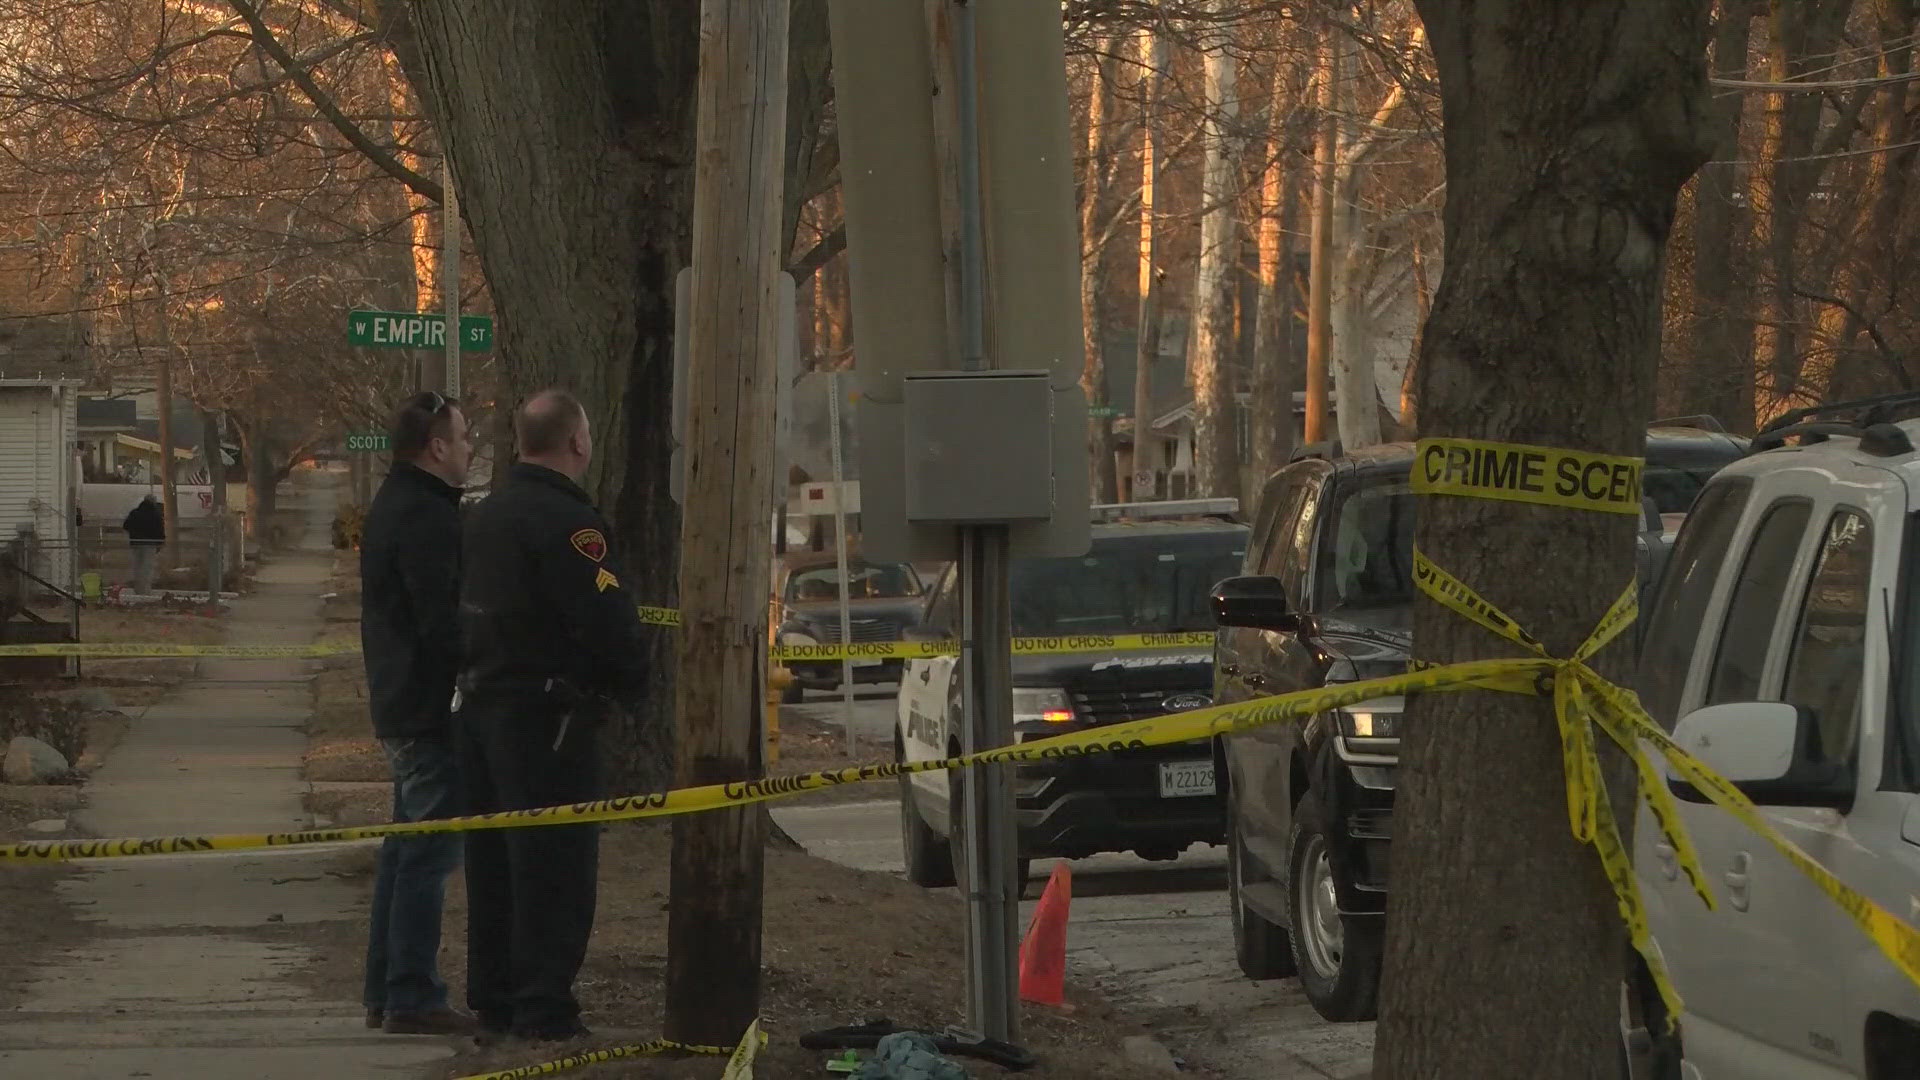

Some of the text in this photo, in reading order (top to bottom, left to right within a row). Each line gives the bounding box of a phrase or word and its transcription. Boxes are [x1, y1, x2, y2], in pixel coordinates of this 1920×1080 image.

[356, 317, 486, 347] W EMPIR ST
[349, 435, 387, 450] SCOTT
[1424, 444, 1642, 503] CRIME SCEN
[793, 645, 813, 657] DO
[816, 644, 842, 657] NOT
[847, 643, 895, 656] CROSS
[1014, 638, 1034, 650] DO
[1037, 637, 1063, 650] NOT
[1068, 636, 1115, 649] CROSS
[1186, 632, 1213, 644] SCE
[1173, 695, 1201, 708] Ford
[1165, 770, 1215, 789] M 22129
